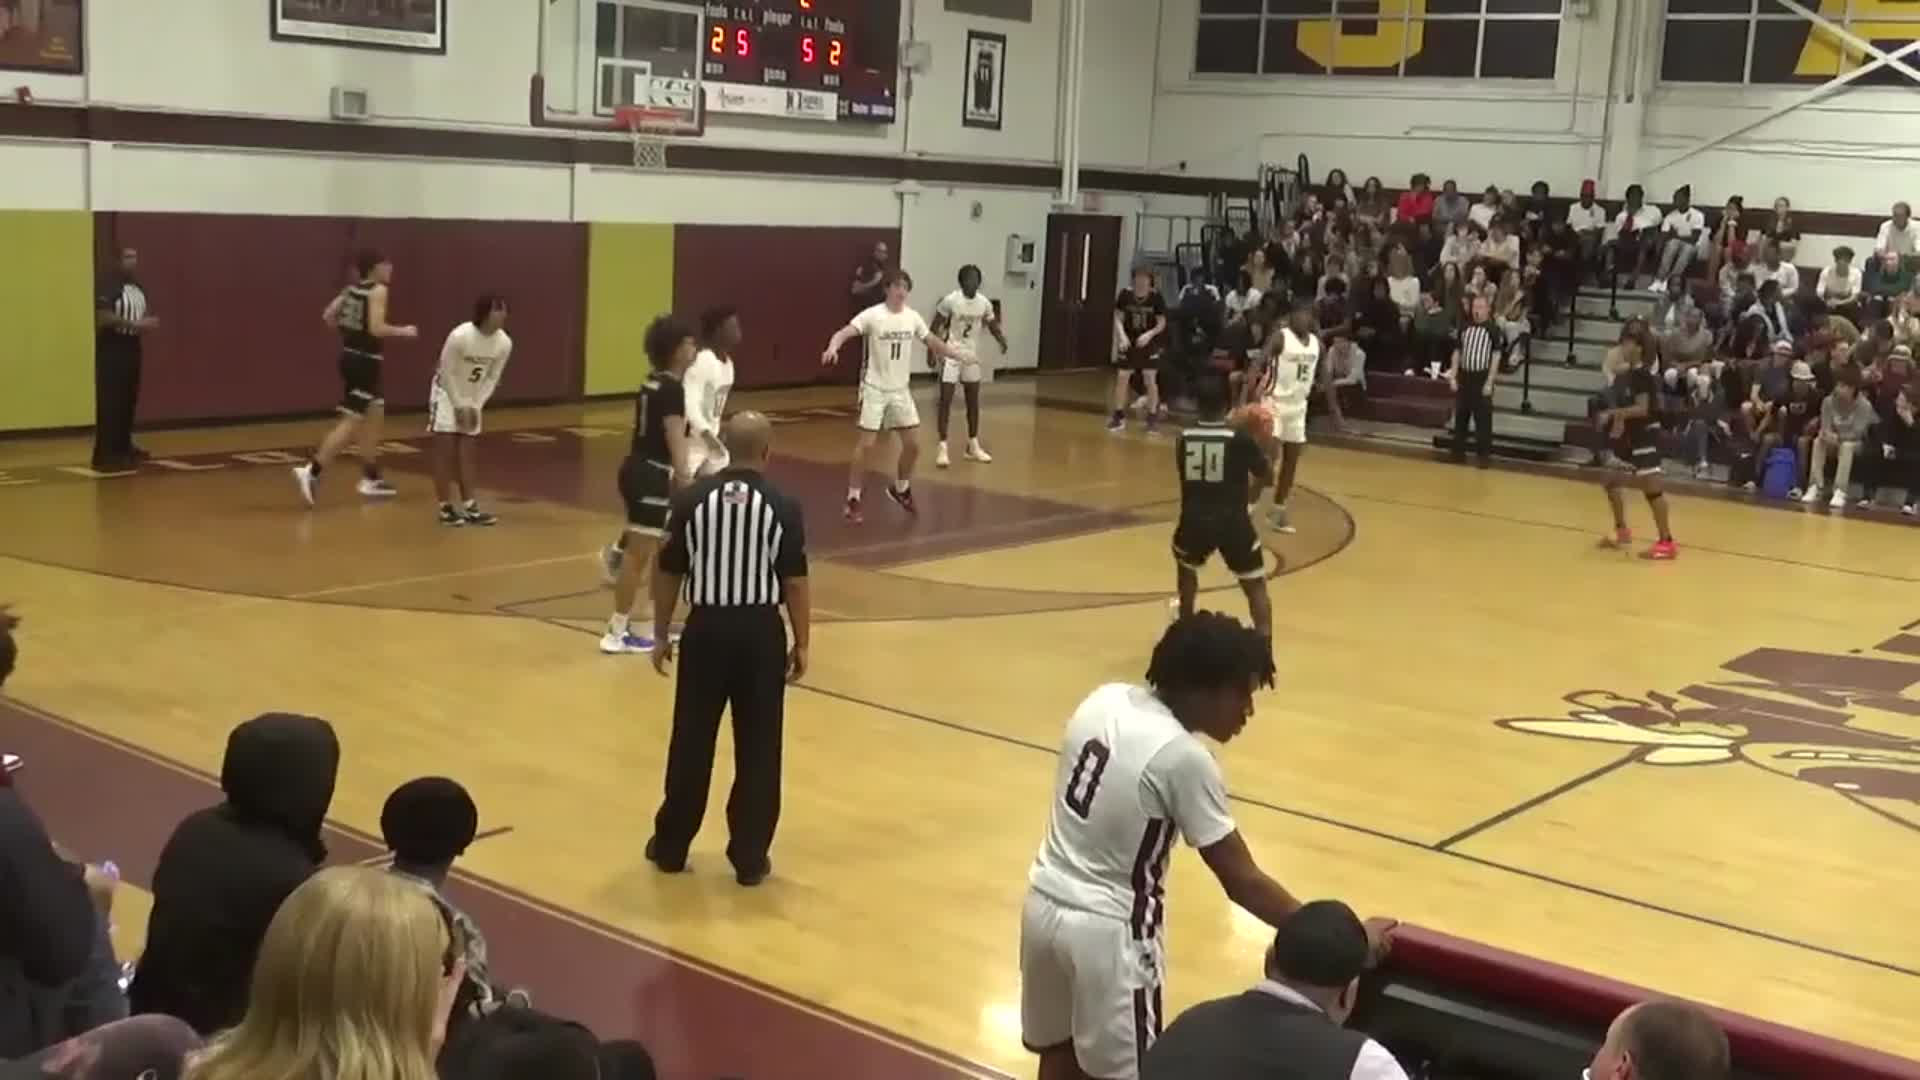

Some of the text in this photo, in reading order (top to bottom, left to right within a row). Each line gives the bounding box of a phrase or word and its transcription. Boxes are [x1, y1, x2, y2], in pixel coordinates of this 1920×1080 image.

[711, 26, 724, 53] 2
[737, 29, 748, 56] 5
[802, 37, 813, 63] 5
[829, 40, 841, 66] 2
[962, 324, 972, 338] 2
[890, 343, 901, 360] 11
[468, 367, 483, 383] 5
[1185, 441, 1224, 482] 20
[1065, 738, 1110, 819] 0
